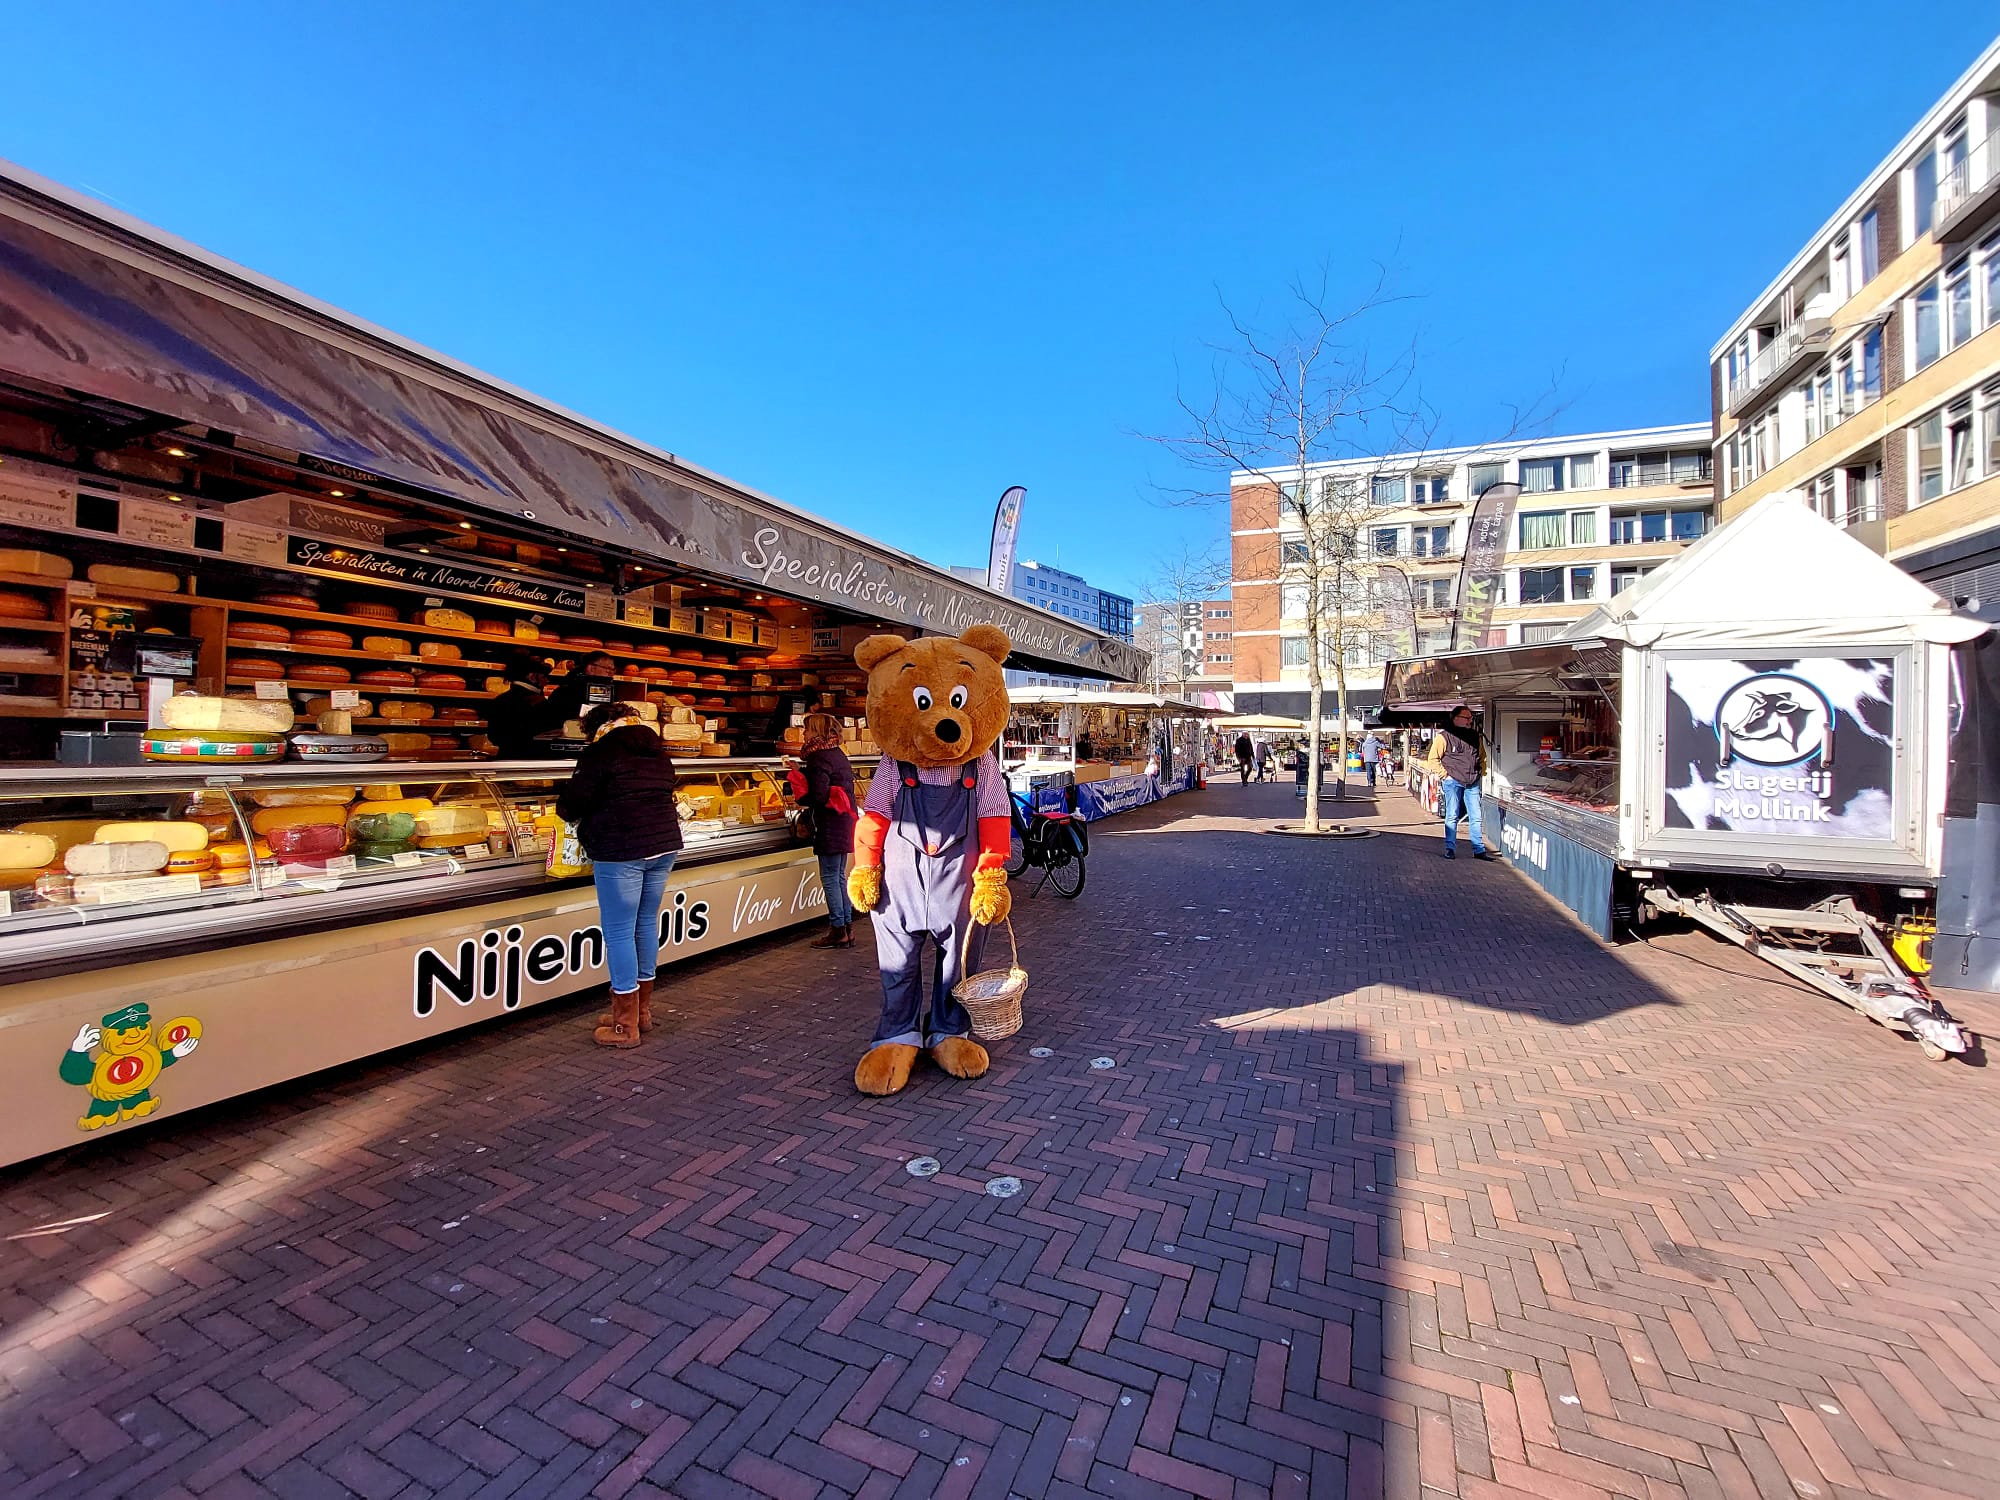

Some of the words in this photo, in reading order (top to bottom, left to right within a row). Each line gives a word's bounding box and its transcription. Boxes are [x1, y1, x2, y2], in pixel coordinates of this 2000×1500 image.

[1492, 502, 1505, 527] tapas
[1490, 528, 1499, 539] &
[296, 543, 407, 577] Specialisten
[412, 566, 428, 581] in
[431, 567, 549, 601] Noord-Hollandse
[553, 590, 584, 608] Kaas
[741, 528, 907, 613] Specialisten
[916, 593, 935, 621] in
[1715, 769, 1832, 799] Slagerij
[1713, 798, 1832, 822] Mollink
[733, 883, 783, 933] Voor
[790, 871, 827, 914] Kaa
